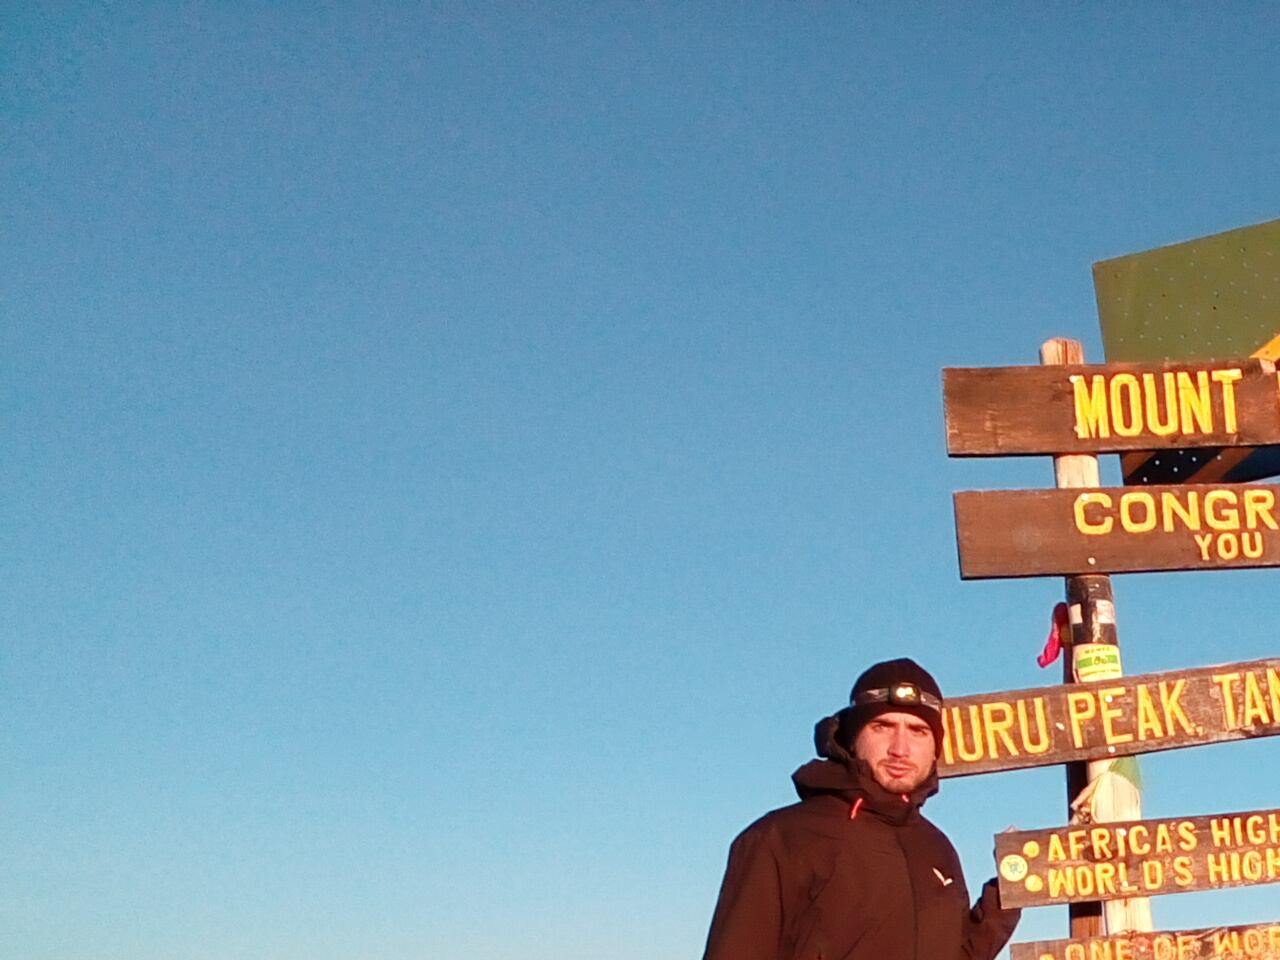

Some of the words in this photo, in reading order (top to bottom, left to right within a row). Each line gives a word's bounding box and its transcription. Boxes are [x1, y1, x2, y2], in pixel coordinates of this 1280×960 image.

[1073, 368, 1243, 439] MOUNT
[1194, 531, 1264, 561] YOU
[1067, 678, 1204, 749] PEAK,
[1047, 821, 1198, 862] AFRICA'S
[1047, 856, 1194, 898] WORLD'S
